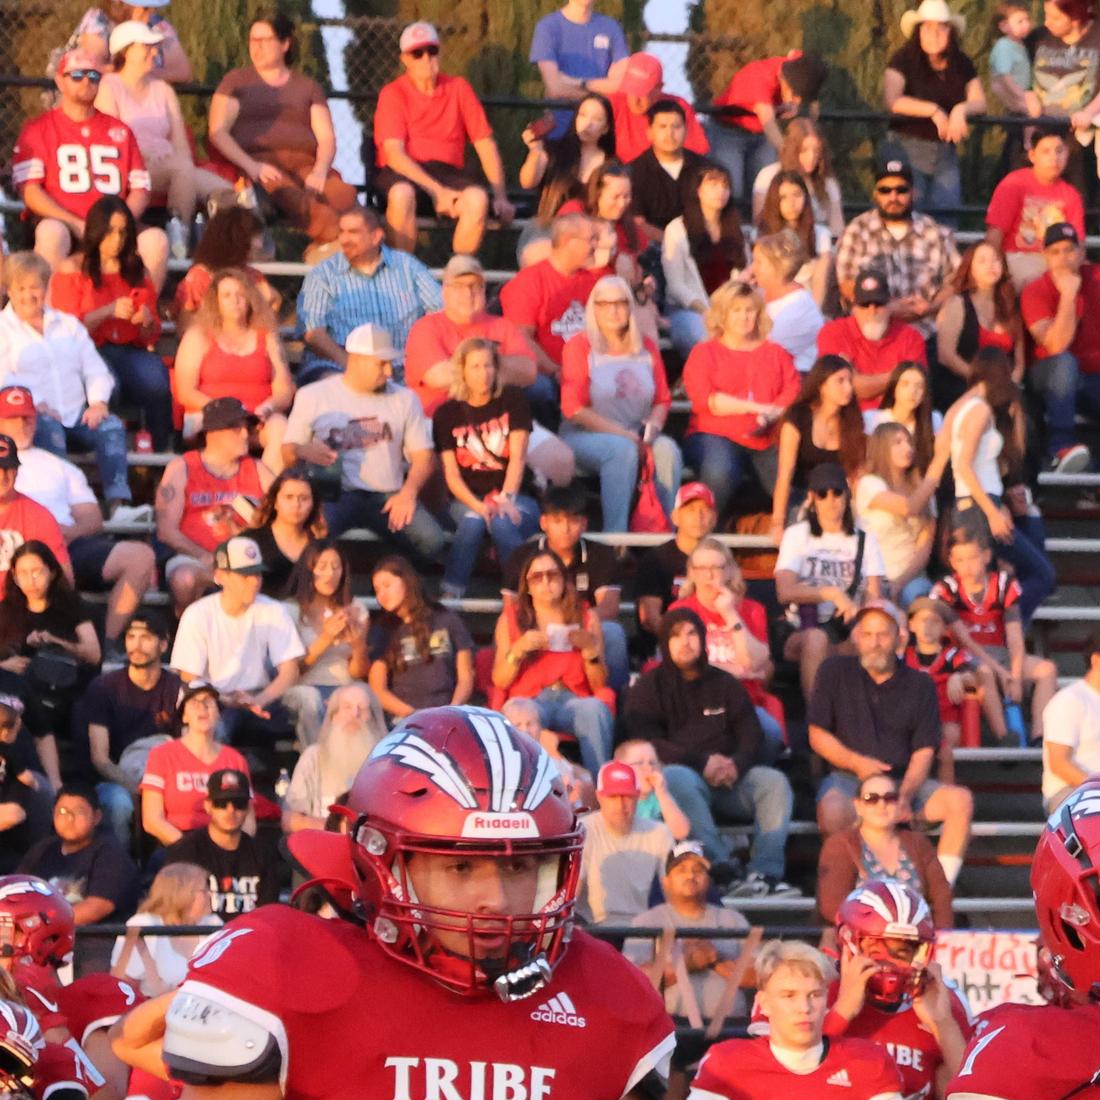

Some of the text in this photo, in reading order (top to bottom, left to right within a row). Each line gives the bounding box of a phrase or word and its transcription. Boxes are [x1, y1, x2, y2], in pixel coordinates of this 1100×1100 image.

[57, 144, 121, 194] 85
[806, 556, 857, 577] TRIB
[474, 816, 531, 830] Riddell
[530, 1009, 586, 1028] adidas
